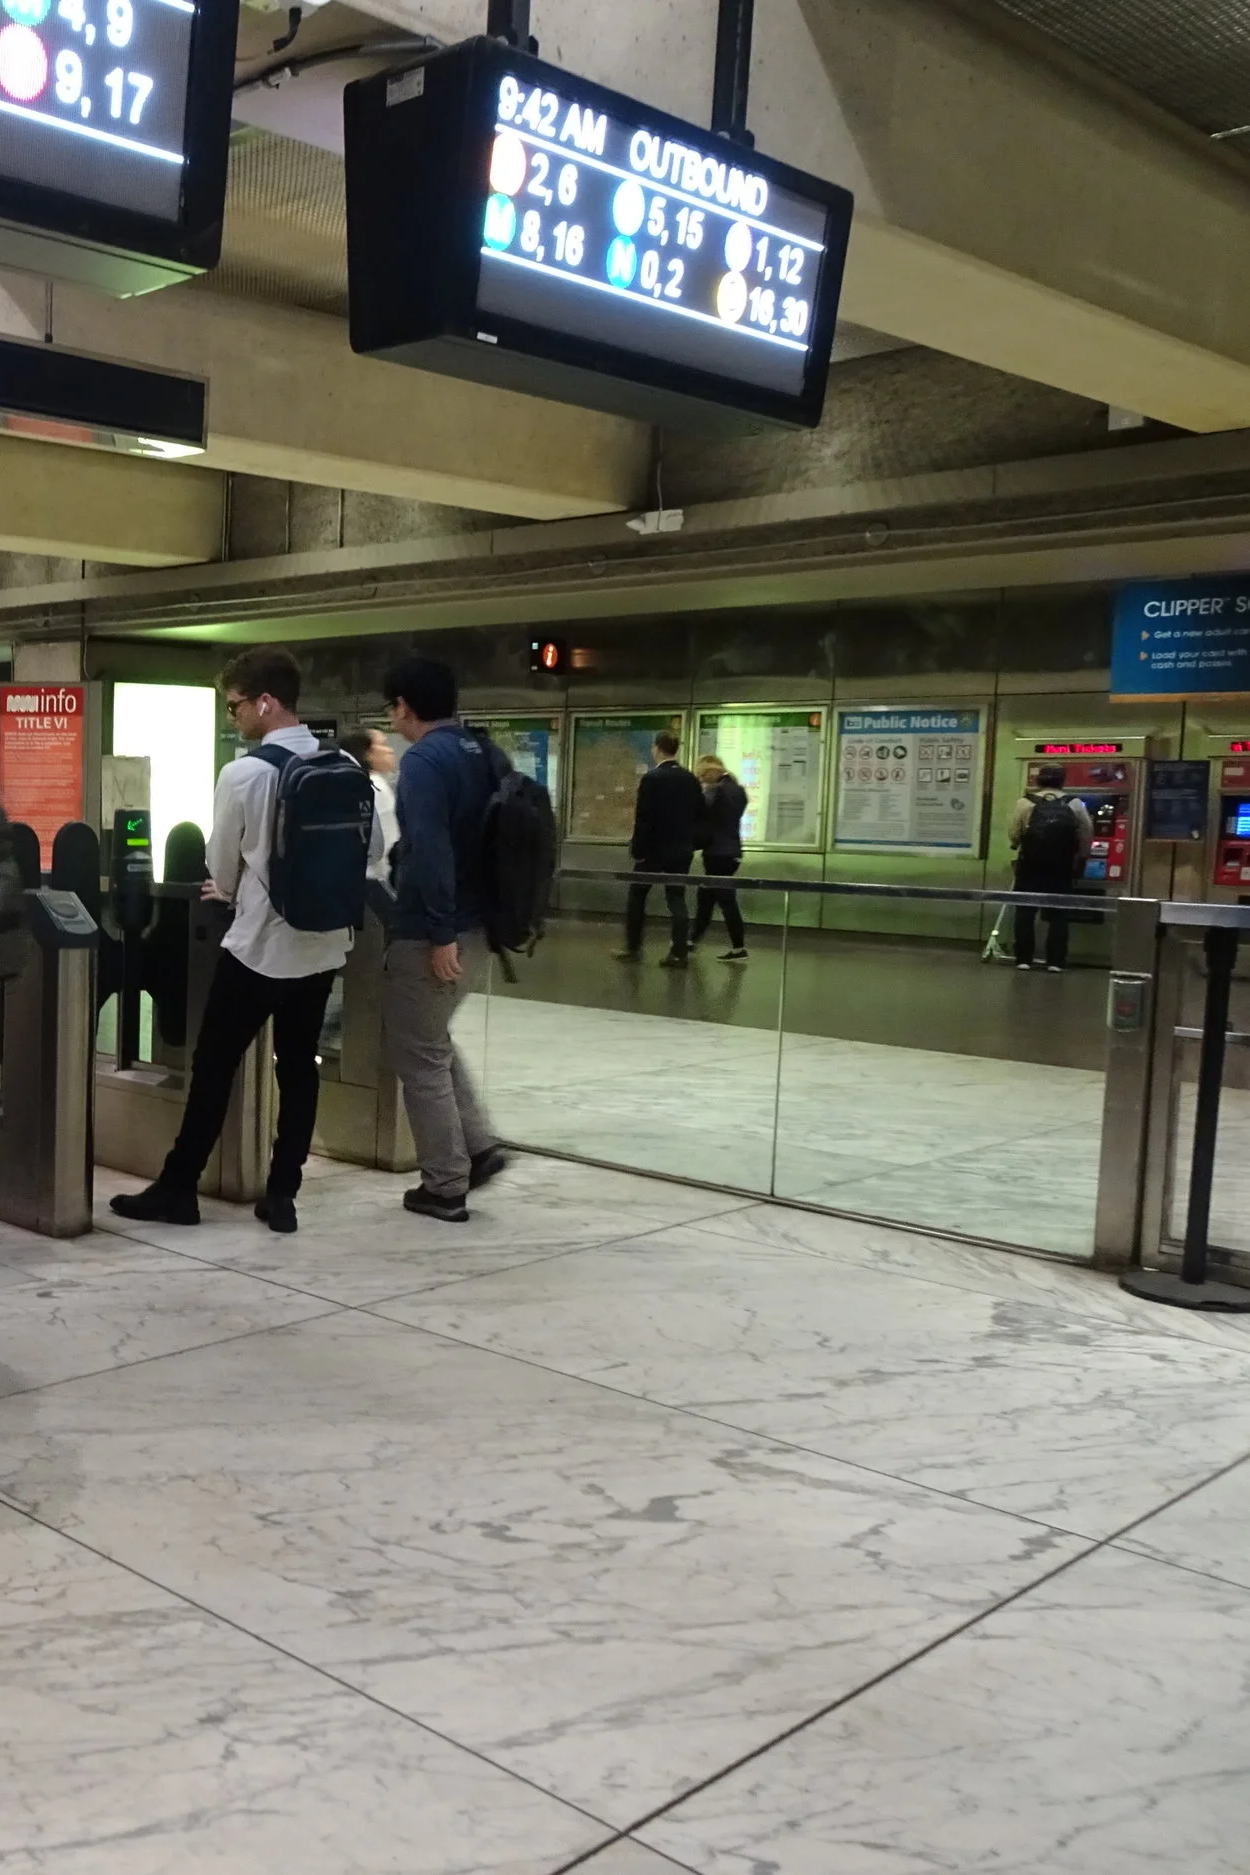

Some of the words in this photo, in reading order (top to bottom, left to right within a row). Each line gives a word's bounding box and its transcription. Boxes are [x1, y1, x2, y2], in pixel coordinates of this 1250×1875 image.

[55, 49, 91, 118] 9,
[105, 67, 153, 125] 17
[498, 76, 558, 138] 9:42
[559, 103, 607, 156] AM
[630, 130, 768, 216] OUTBOUND
[528, 152, 553, 206] 2,
[647, 196, 669, 246] 5,
[676, 207, 705, 250] 15
[756, 236, 773, 281] 1,
[778, 244, 804, 285] 12
[1143, 597, 1224, 618] CLIPPER
[1234, 595, 1250, 613] S
[15, 716, 52, 730] TITLE
[53, 716, 68, 730] VI
[41, 687, 77, 713] info
[863, 715, 907, 729] Public
[910, 714, 958, 728] Notice
